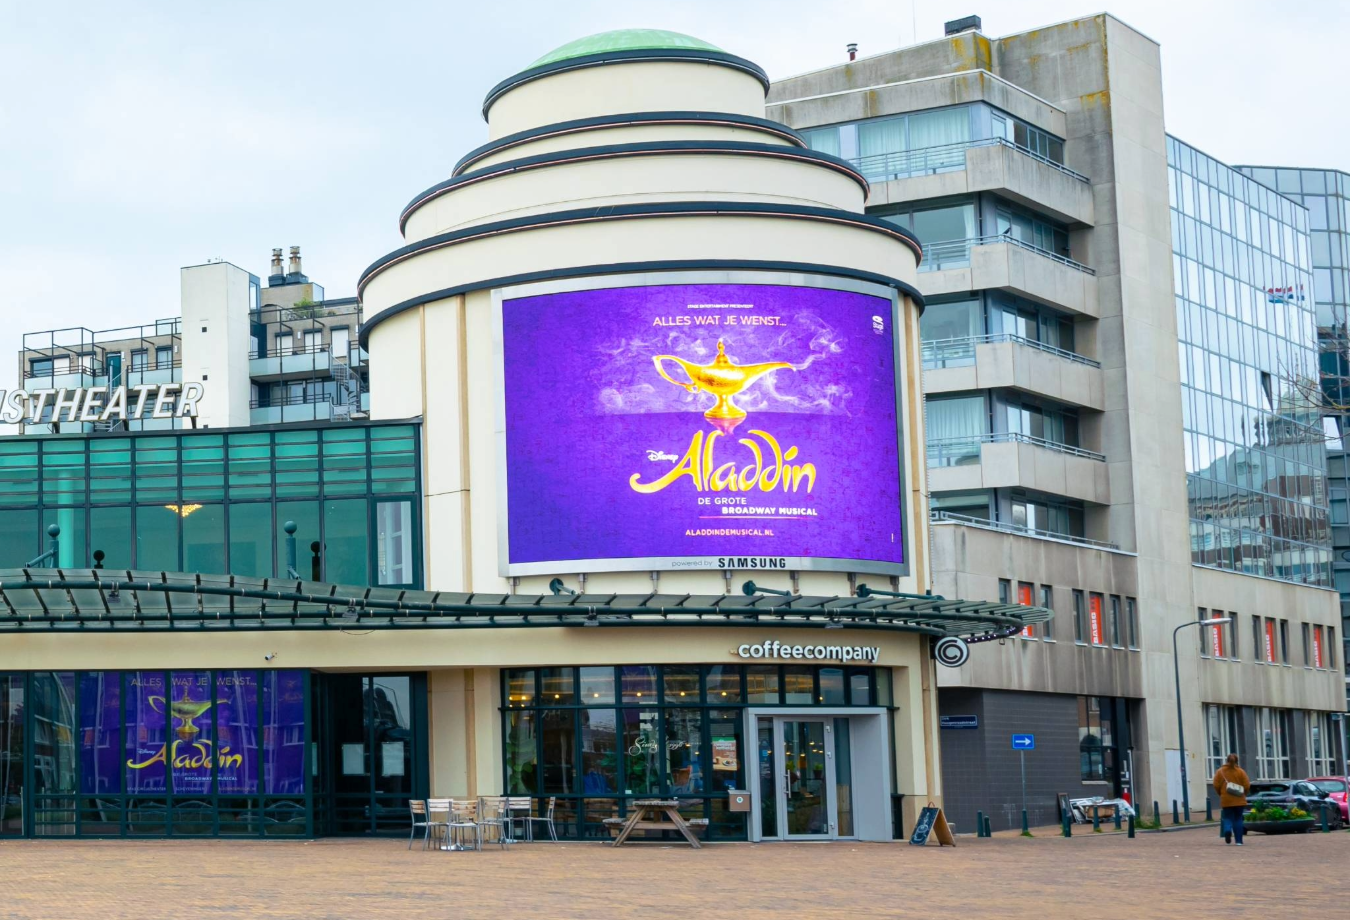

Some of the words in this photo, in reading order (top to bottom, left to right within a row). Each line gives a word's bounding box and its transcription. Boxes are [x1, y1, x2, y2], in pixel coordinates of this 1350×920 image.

[653, 316, 691, 326] ALLES
[693, 315, 721, 326] WAT
[723, 315, 738, 326] JE
[740, 315, 787, 327] WENST...
[629, 430, 817, 493] Aladdin
[646, 449, 679, 463] Disney
[697, 497, 711, 505] DE
[714, 497, 747, 505] GROTE
[721, 506, 776, 515] BROADWAY
[778, 507, 818, 516] MUSICAL
[685, 528, 774, 537] ALADDINDEMUSICAL.NL
[671, 560, 702, 568] powered
[704, 559, 714, 568] by
[718, 557, 786, 569] SAMSUNG
[1091, 611, 1099, 644] BASIC
[738, 640, 880, 662] coffeecompany
[131, 677, 162, 686] ALLES
[171, 677, 193, 686] WAT
[196, 677, 208, 686] JE
